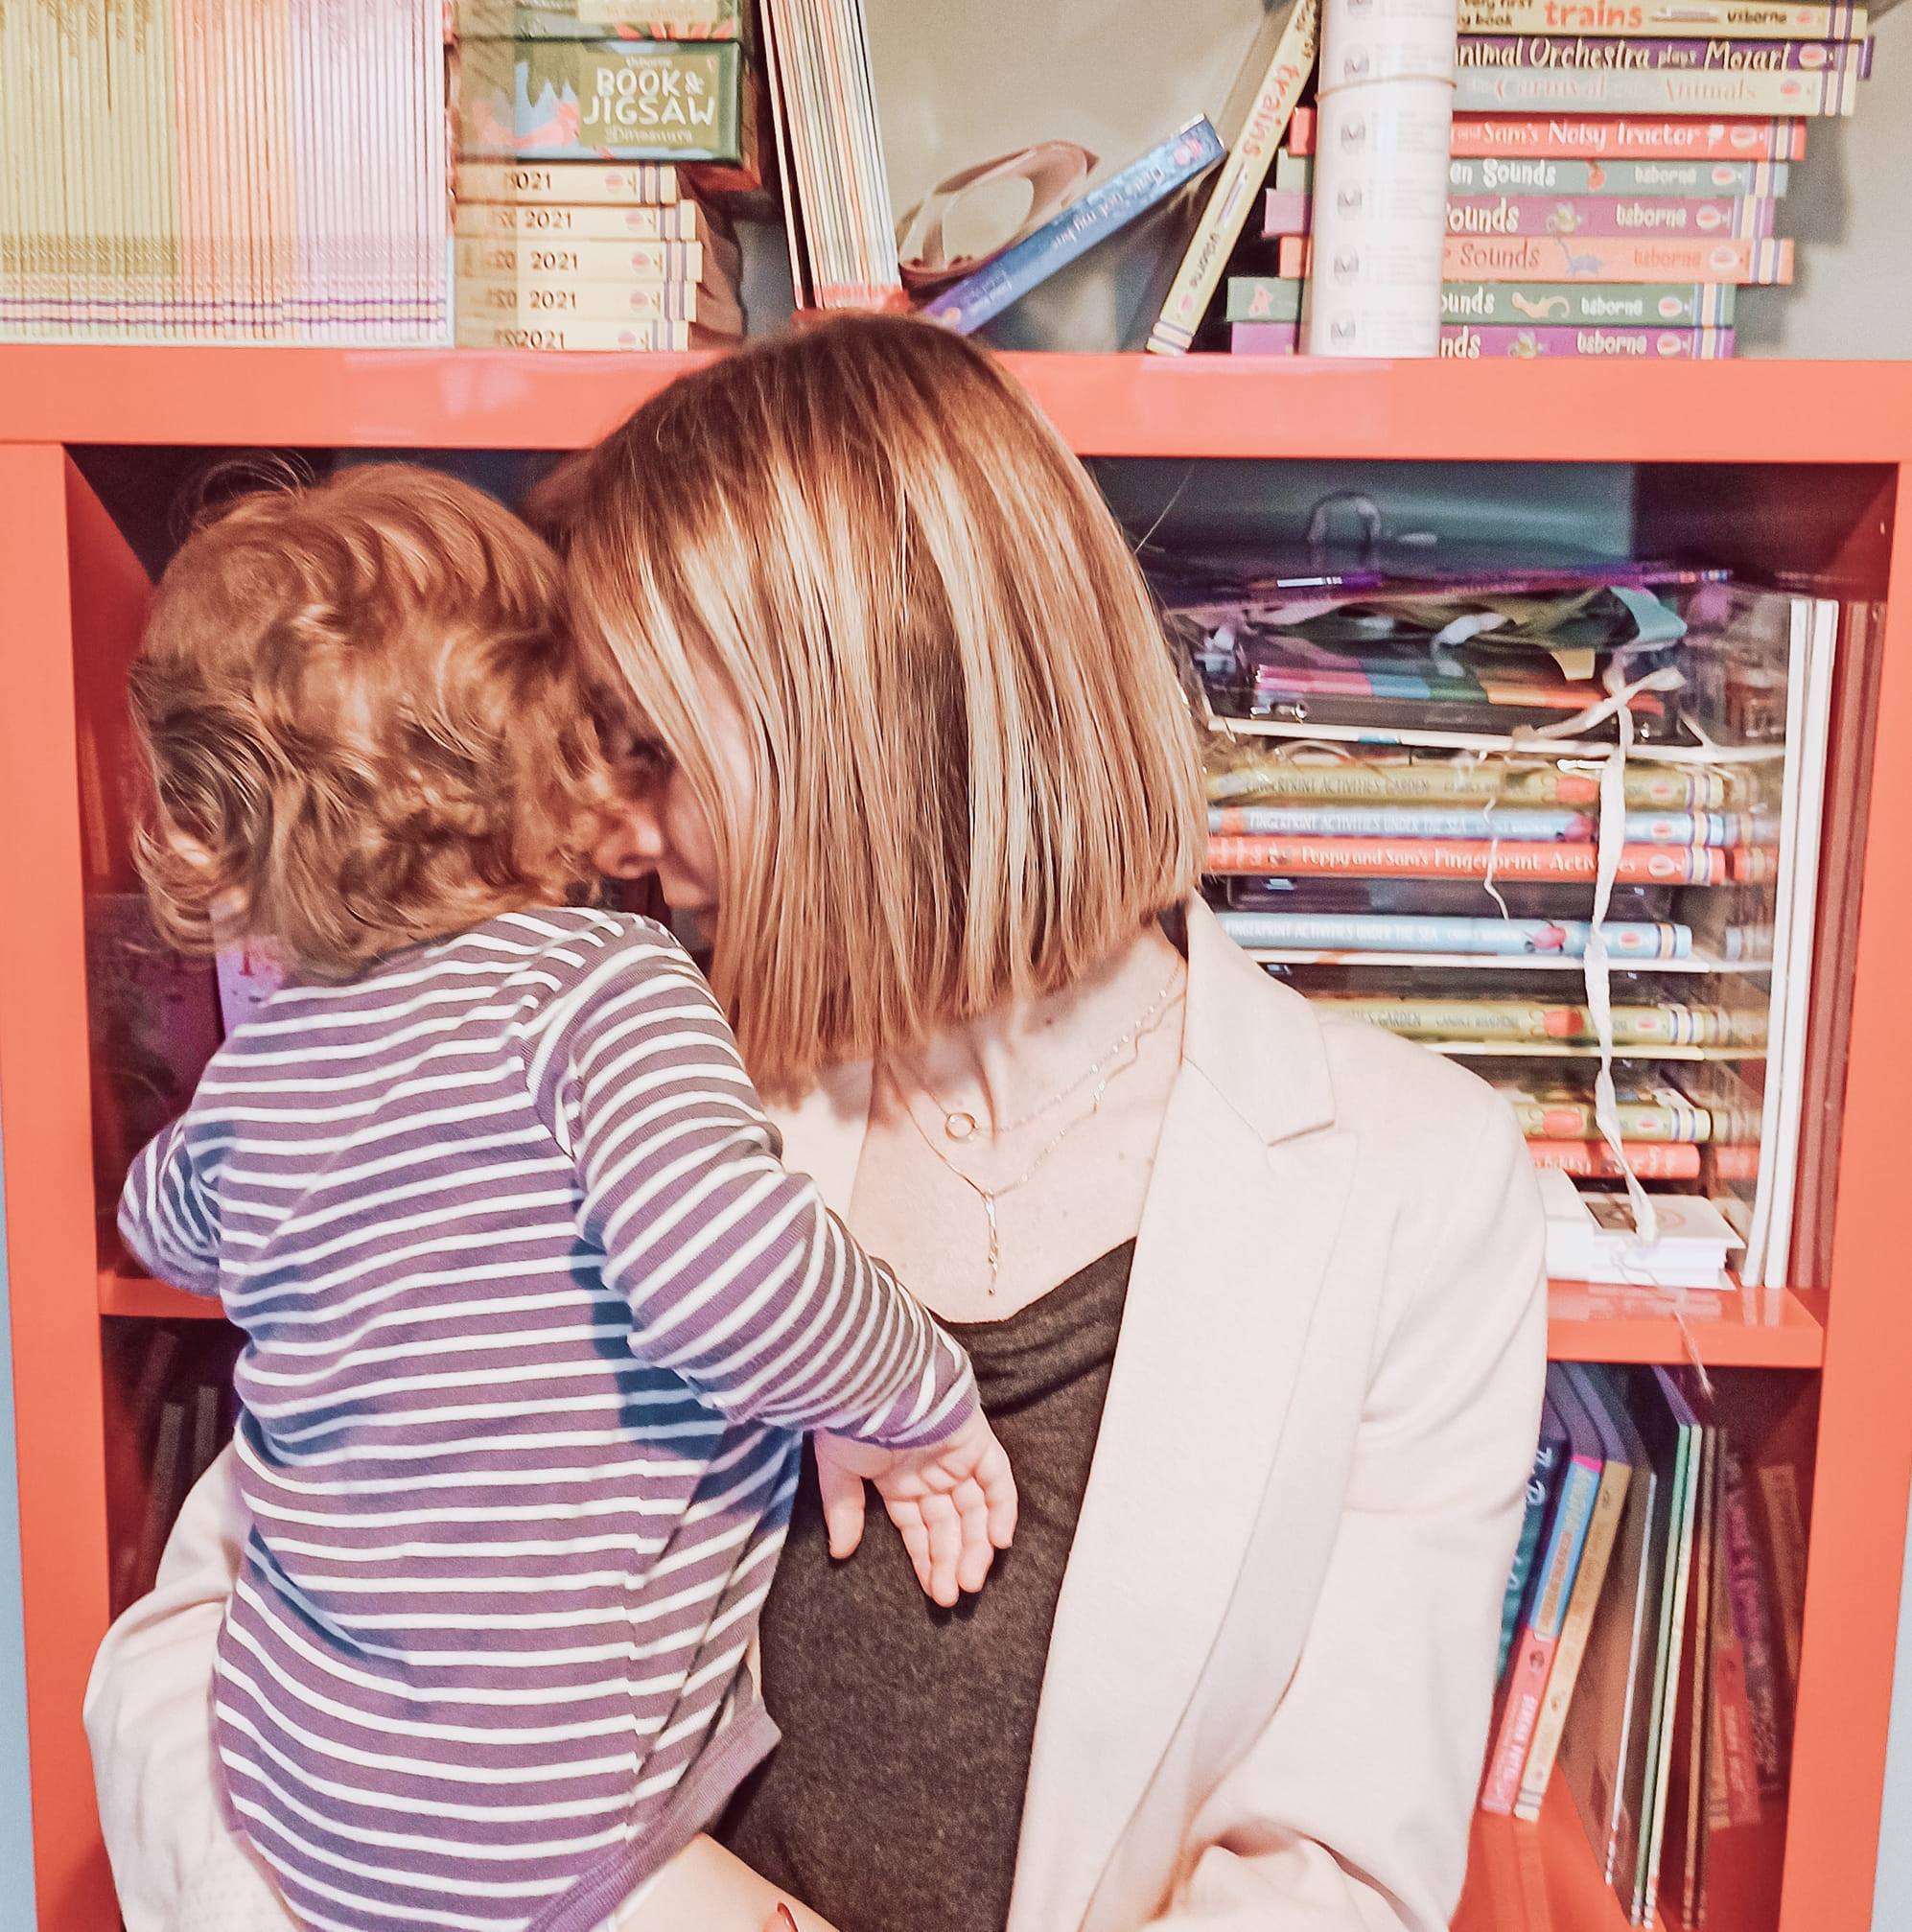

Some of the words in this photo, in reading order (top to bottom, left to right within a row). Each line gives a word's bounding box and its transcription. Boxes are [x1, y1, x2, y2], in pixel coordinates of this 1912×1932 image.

[1546, 0, 1643, 28] trains
[1457, 38, 1523, 68] nimal
[1530, 37, 1650, 70] Orchestra
[1704, 41, 1791, 70] Mozart
[596, 66, 681, 97] BOOK
[685, 70, 705, 95] &
[583, 95, 715, 125] JIGSAW
[1243, 63, 1299, 155] trains
[1549, 120, 1607, 151] Noisy
[1618, 122, 1701, 145] Tractor
[1482, 158, 1556, 188] Sounds
[525, 210, 571, 229] 2021
[1446, 197, 1520, 233] ounds
[530, 250, 577, 269] 2021
[1459, 239, 1541, 269] Sounds
[529, 290, 575, 309] 2021
[1440, 286, 1495, 315] ounds
[1301, 846, 1349, 868] Poppy
[1352, 849, 1382, 866] and
[1386, 850, 1429, 867] Sam's
